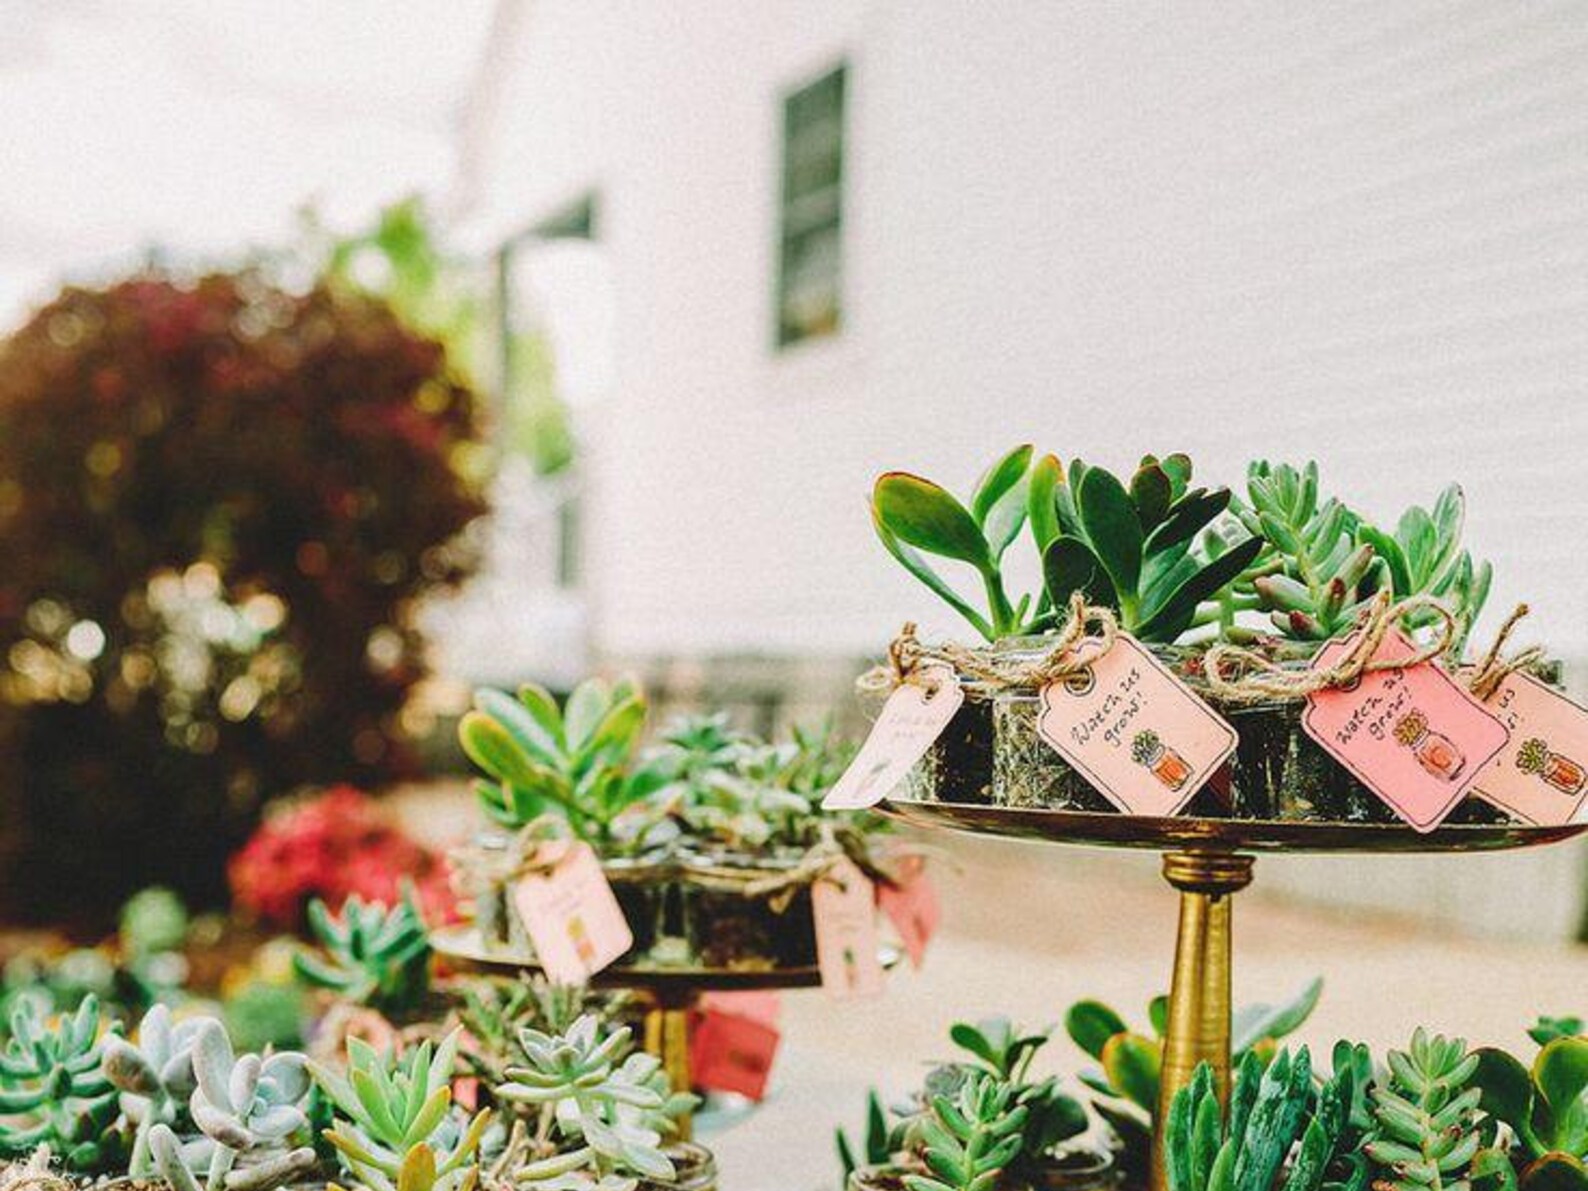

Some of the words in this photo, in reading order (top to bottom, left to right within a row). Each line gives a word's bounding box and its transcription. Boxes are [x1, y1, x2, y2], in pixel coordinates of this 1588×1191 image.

[1070, 693, 1121, 745] Watch
[1118, 667, 1142, 692] us
[1103, 692, 1149, 747] grow!
[1335, 697, 1383, 745] Watch
[1383, 668, 1405, 690] us
[1368, 686, 1412, 741] grow!
